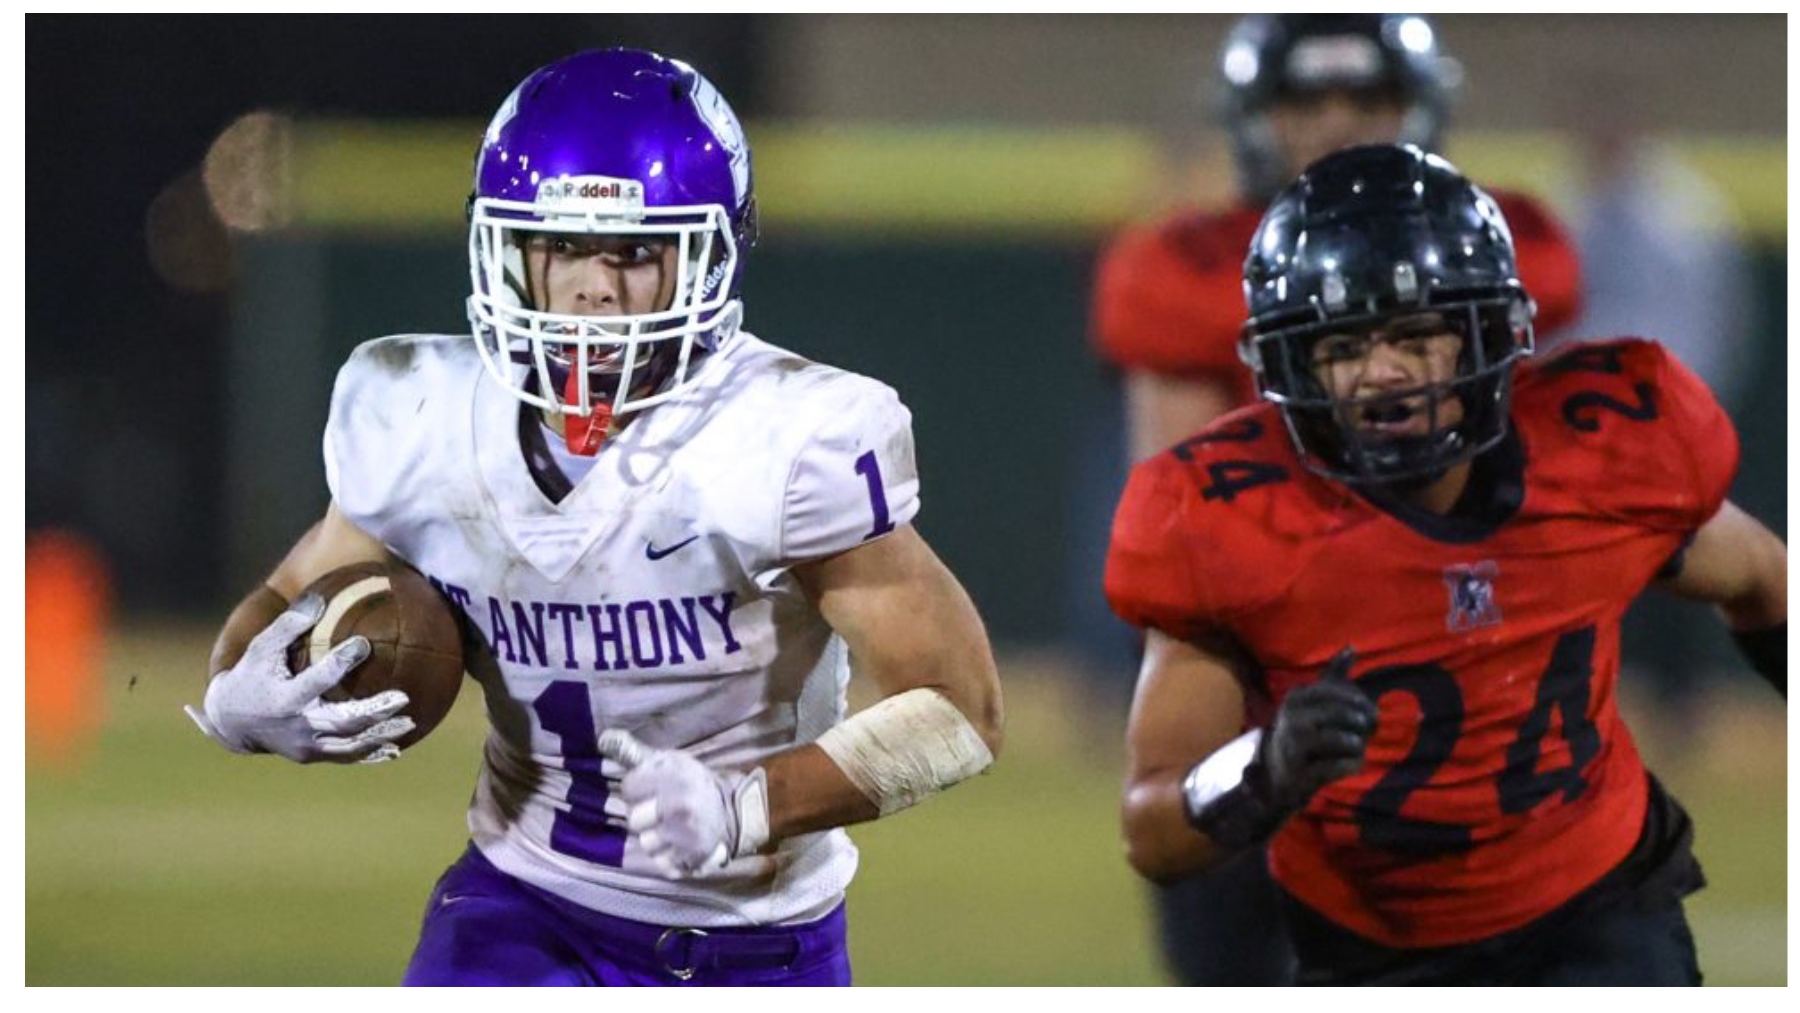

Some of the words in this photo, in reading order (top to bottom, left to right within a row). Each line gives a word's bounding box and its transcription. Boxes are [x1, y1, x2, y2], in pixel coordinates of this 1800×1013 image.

[853, 448, 896, 542] 1
[487, 590, 743, 670] ANTHONY
[532, 679, 629, 868] 1
[1350, 622, 1604, 861] 24
